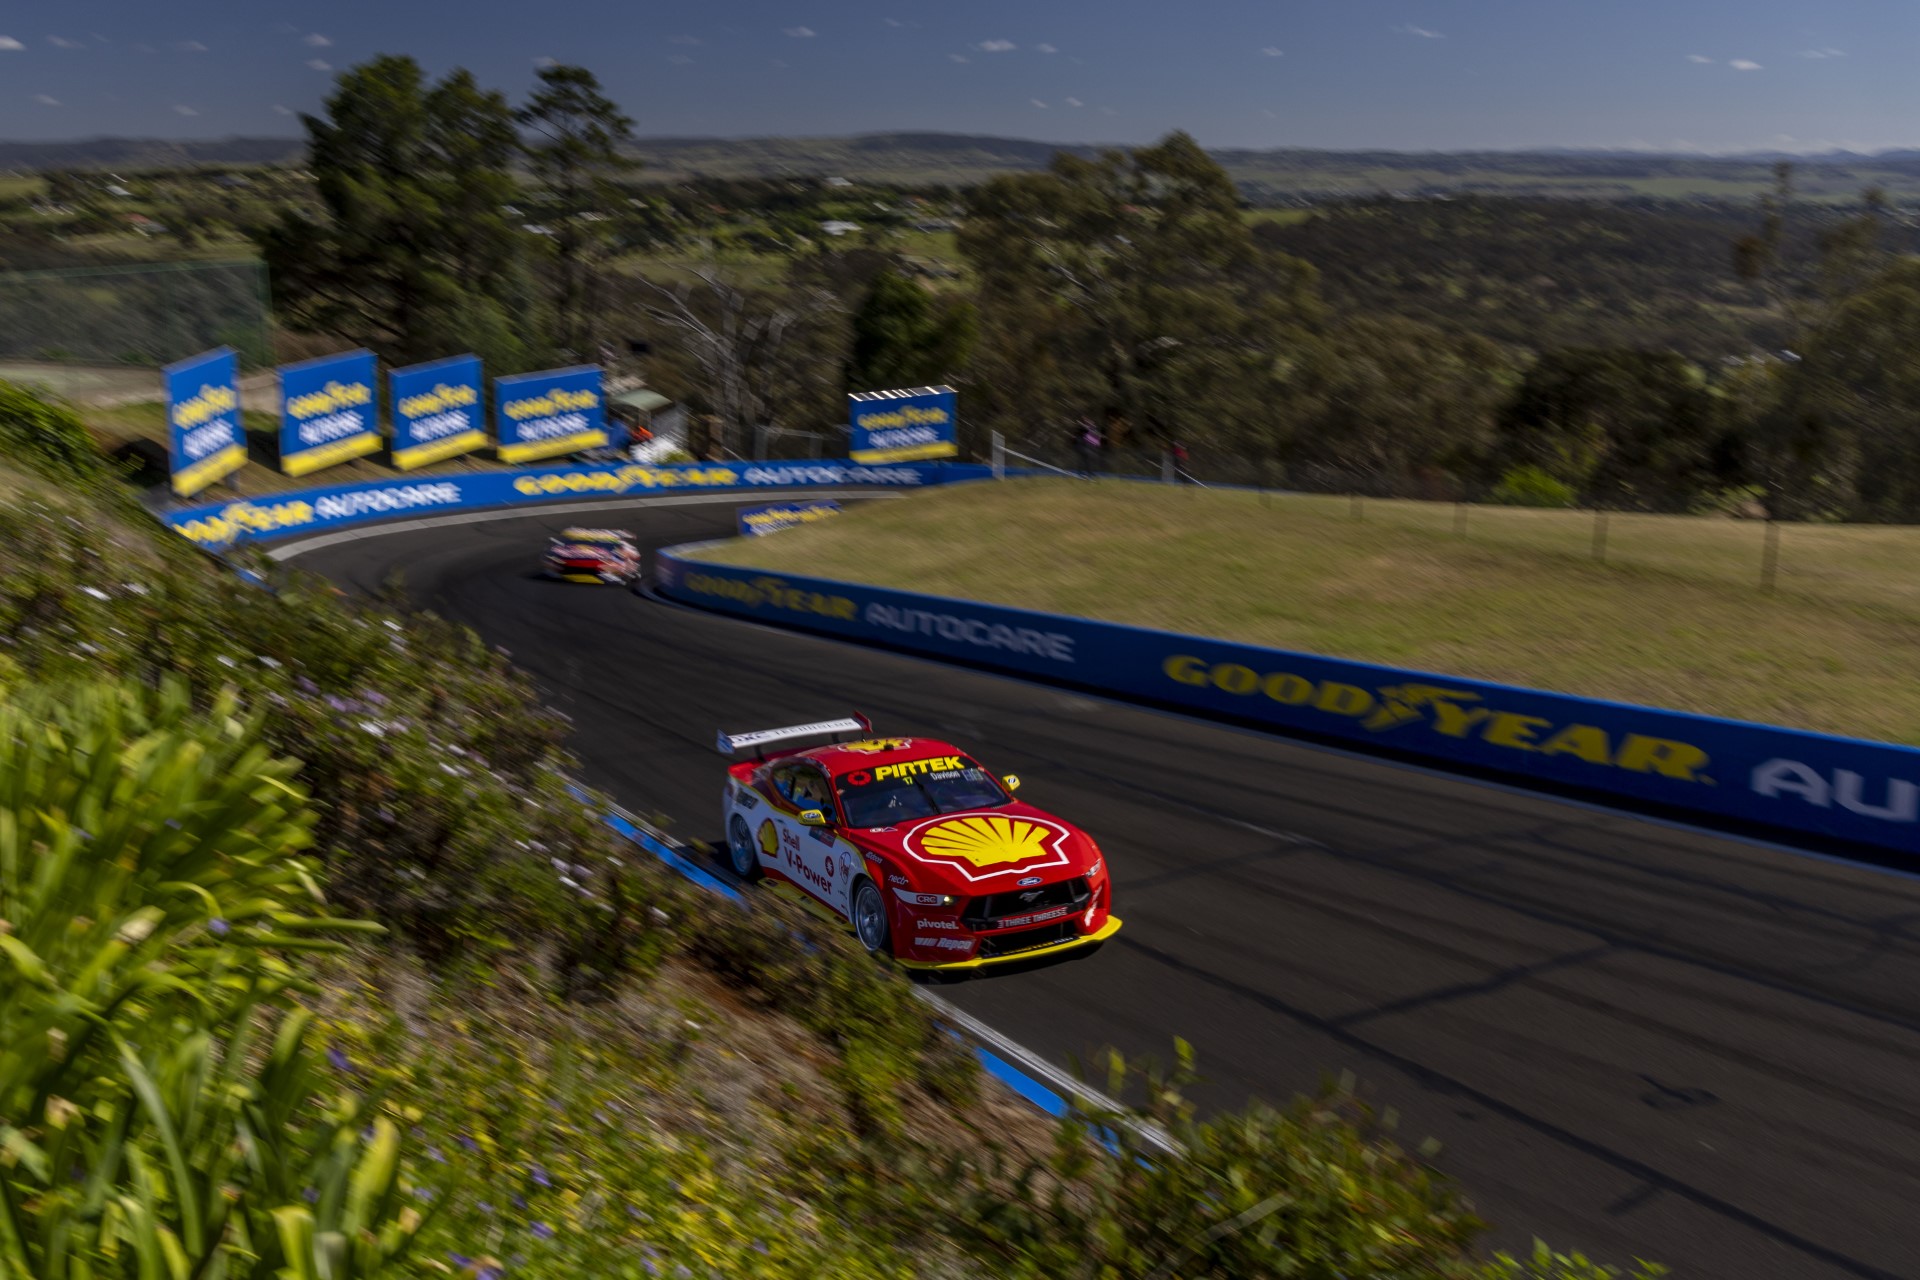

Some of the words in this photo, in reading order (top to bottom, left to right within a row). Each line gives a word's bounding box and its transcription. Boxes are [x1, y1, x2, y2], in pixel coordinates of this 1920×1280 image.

[865, 602, 1077, 663] AUTOCARE
[1162, 654, 1712, 783] GOODYEAR
[875, 756, 965, 782] PIRTEK
[903, 776, 913, 785] 17
[782, 828, 800, 851] Shell
[784, 847, 832, 894] V-Power
[917, 895, 937, 904] CRC
[1005, 916, 1032, 927] THREE
[1033, 908, 1063, 922] THREES
[937, 937, 973, 950] Repco
